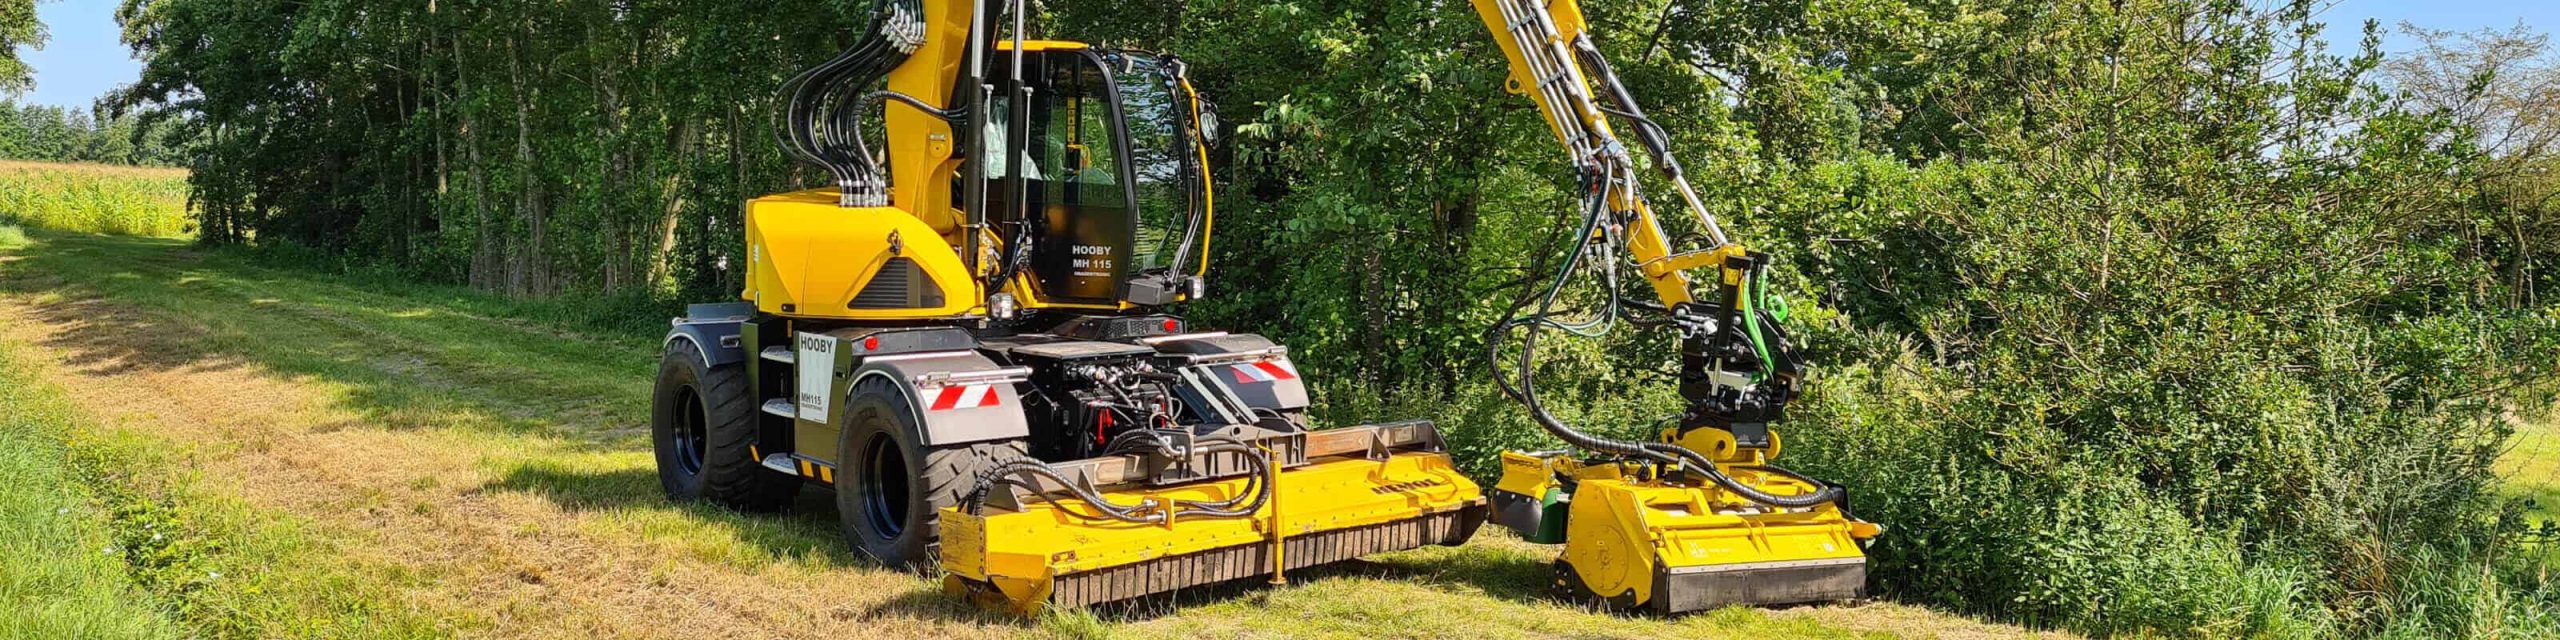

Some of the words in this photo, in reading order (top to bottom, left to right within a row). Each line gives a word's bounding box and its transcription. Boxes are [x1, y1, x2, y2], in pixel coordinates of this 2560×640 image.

[1072, 245, 1112, 255] HOOBY
[1073, 259, 1090, 268] MH
[1093, 260, 1112, 269] 115
[800, 335, 833, 354] HOOBY
[801, 392, 822, 406] MH115
